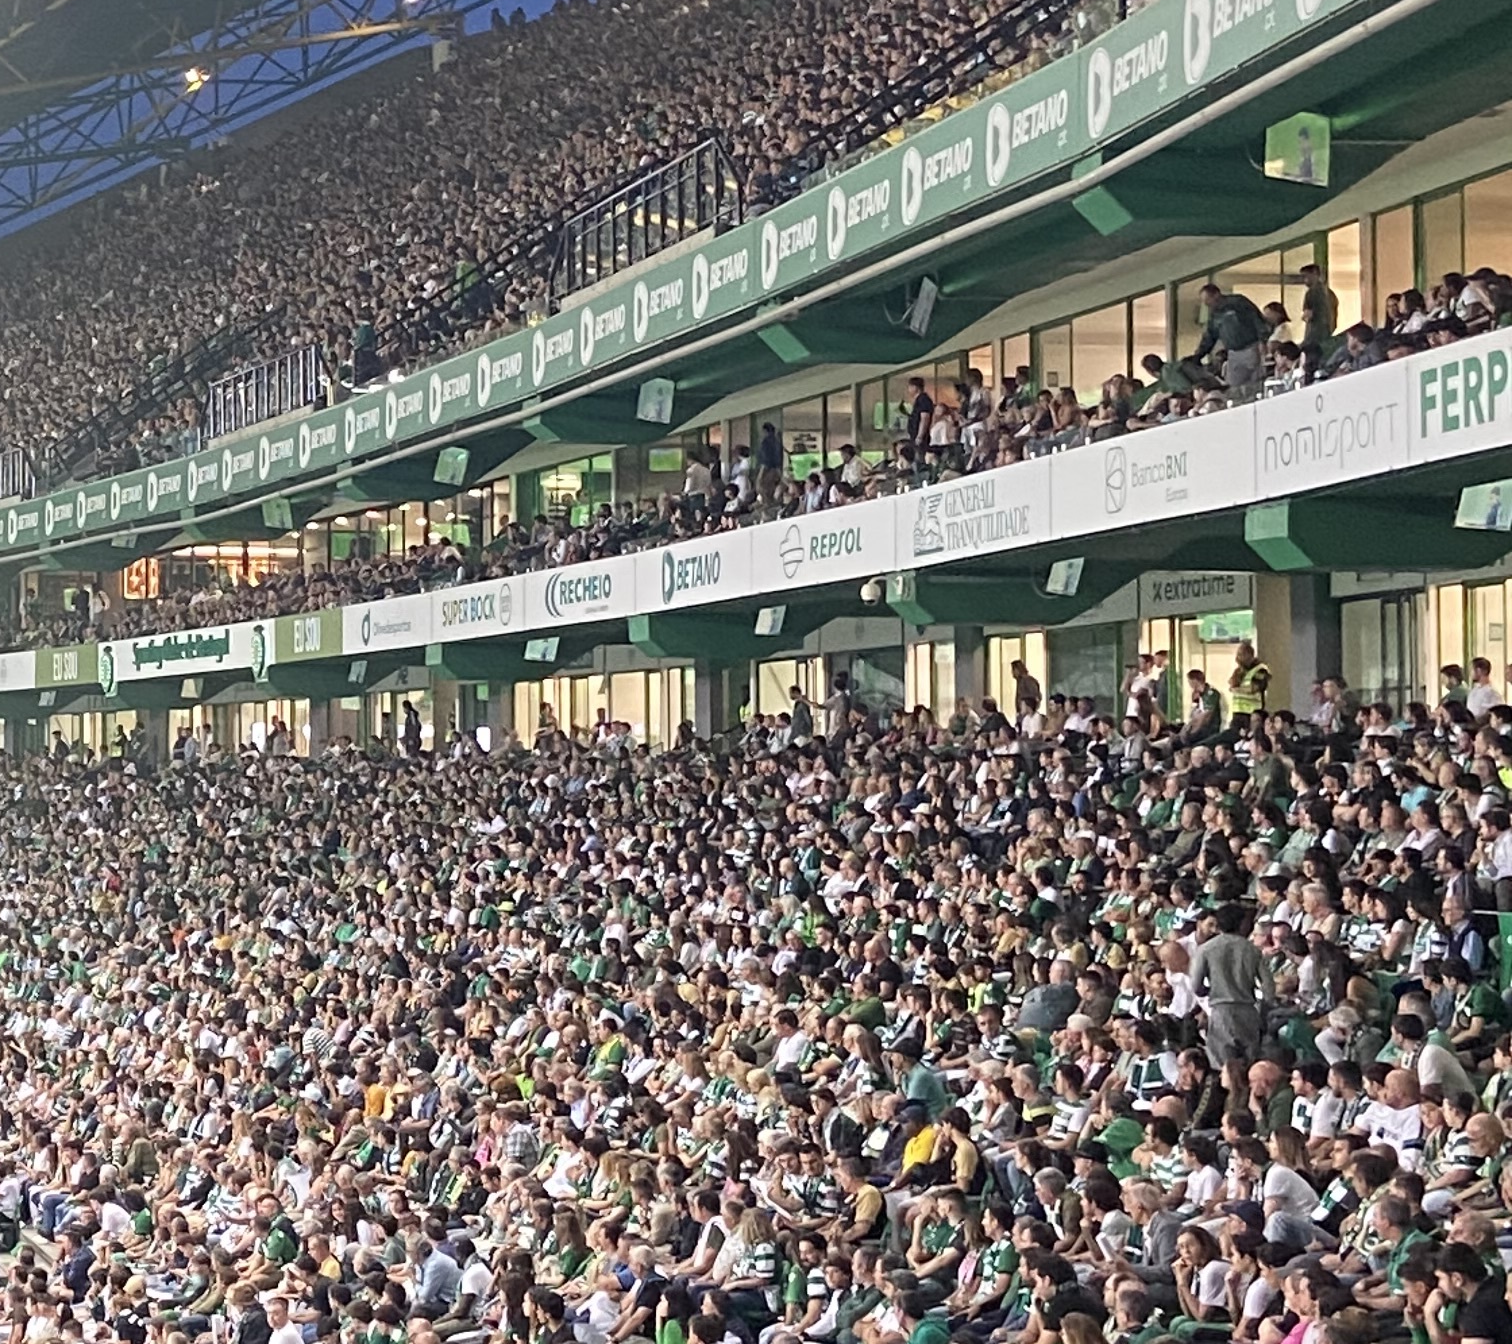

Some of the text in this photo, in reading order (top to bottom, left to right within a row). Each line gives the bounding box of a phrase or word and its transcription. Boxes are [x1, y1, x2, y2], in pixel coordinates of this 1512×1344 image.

[1112, 30, 1168, 96] BETANO
[1012, 90, 1068, 148] BETANO
[923, 137, 973, 190] BETANO
[847, 179, 890, 227] BETANO
[779, 215, 818, 259] BETANO
[709, 248, 748, 291] BETANO
[649, 278, 684, 316] BETANO
[1420, 347, 1512, 438] FERP
[945, 479, 995, 518] GENERALI
[809, 527, 862, 561] REPSOL
[945, 505, 1029, 552] TRANQUILIDADE
[559, 573, 612, 606] RECHEIO
[675, 551, 721, 591] BETANO
[1164, 575, 1235, 601] extratime
[441, 593, 495, 627] SUPER BOCK
